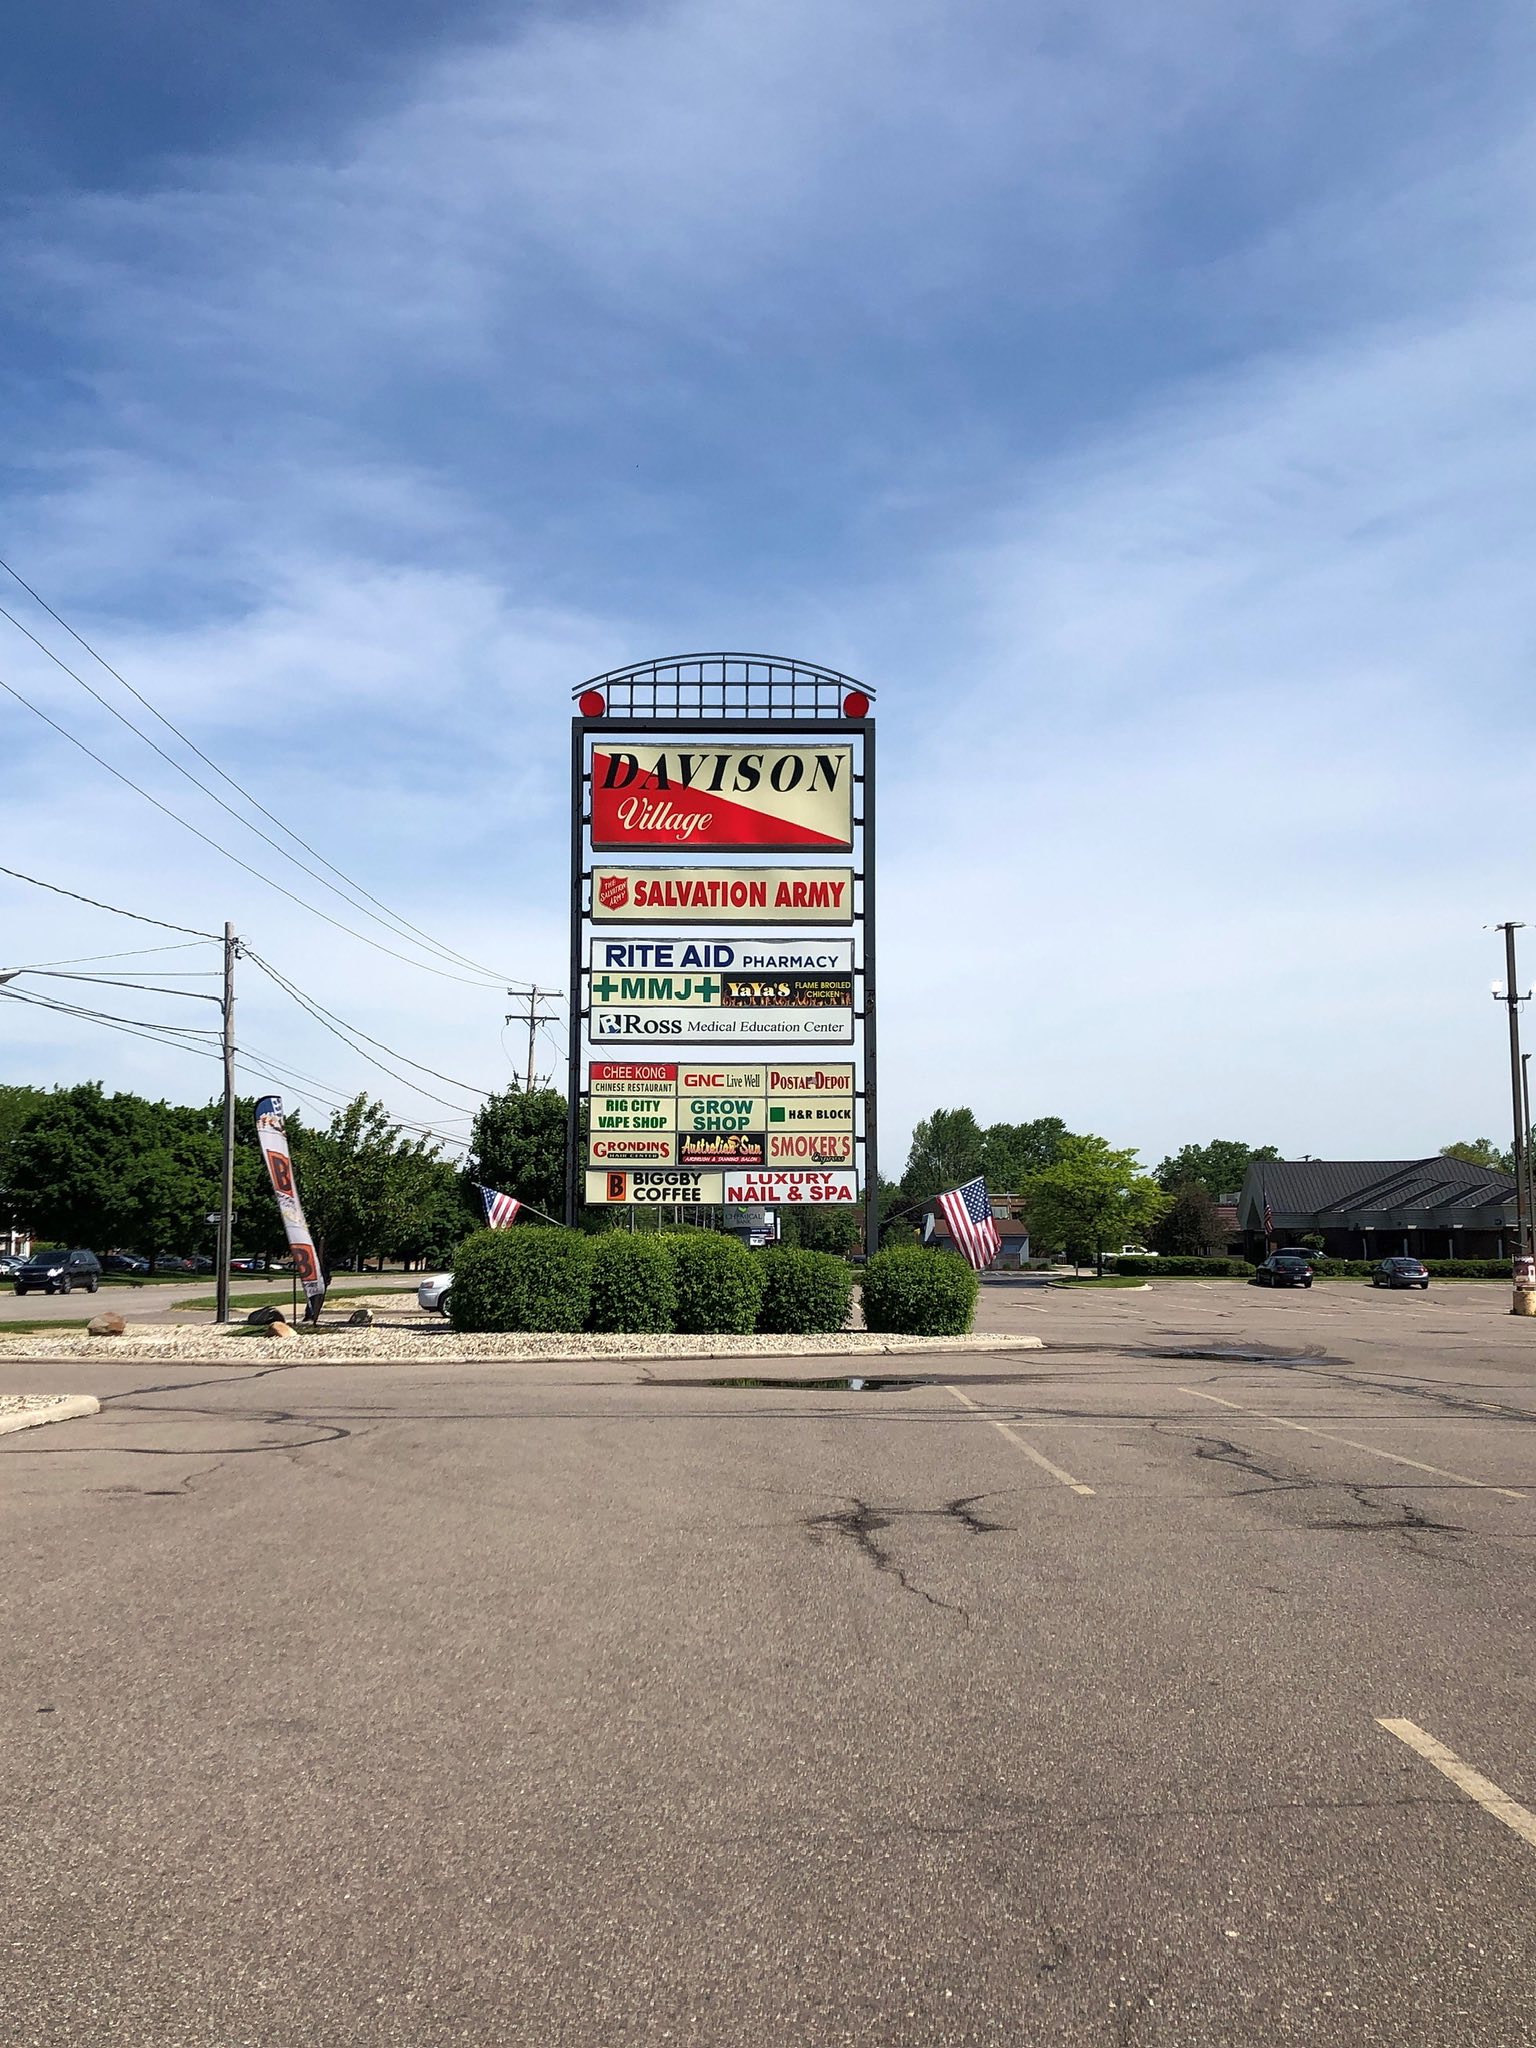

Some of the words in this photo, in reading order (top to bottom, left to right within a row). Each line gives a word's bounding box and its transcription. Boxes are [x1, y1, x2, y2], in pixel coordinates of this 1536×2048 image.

[600, 753, 846, 792] DAVISON
[617, 797, 713, 840] Village
[633, 880, 767, 908] SALVATION
[774, 881, 846, 908] ARMY
[606, 945, 674, 967] RITE
[680, 945, 735, 967] AID
[743, 956, 839, 968] PHARMACY
[795, 981, 819, 989] FLAME
[820, 981, 851, 989] BROILED
[806, 990, 840, 998] CHICKEN
[687, 1021, 736, 1032] Medical
[740, 1021, 800, 1032] Education
[803, 1021, 844, 1032] Center
[603, 1066, 632, 1079] CHEE
[635, 1066, 666, 1079] KONG
[595, 1082, 625, 1092] CHINESE
[627, 1083, 673, 1092] RESTAURANT
[684, 1074, 725, 1087] GNC
[727, 1075, 743, 1088] Live
[743, 1074, 760, 1088] Well
[815, 1071, 850, 1089] DEPOT
[606, 1100, 628, 1112] RIG
[631, 1100, 661, 1112] CITY
[690, 1100, 753, 1114] GROW
[788, 1110, 813, 1120] H&R
[816, 1110, 851, 1120] BLOCK
[598, 1116, 630, 1128] VAPE
[632, 1116, 667, 1129] SHOP
[693, 1116, 750, 1131] SHOP
[593, 1141, 670, 1158] GRONDINS
[681, 1135, 737, 1155] Australian
[739, 1135, 763, 1155] Sun
[770, 1136, 851, 1157] SMOKER'S
[811, 1152, 846, 1164] Express
[633, 1172, 703, 1186] BIGGBY
[746, 1173, 833, 1185] LUXURY
[609, 1175, 624, 1198] B
[633, 1187, 701, 1201] COFFEE
[728, 1187, 781, 1202] NAIL
[787, 1186, 803, 1201] &
[809, 1186, 853, 1201] SPA
